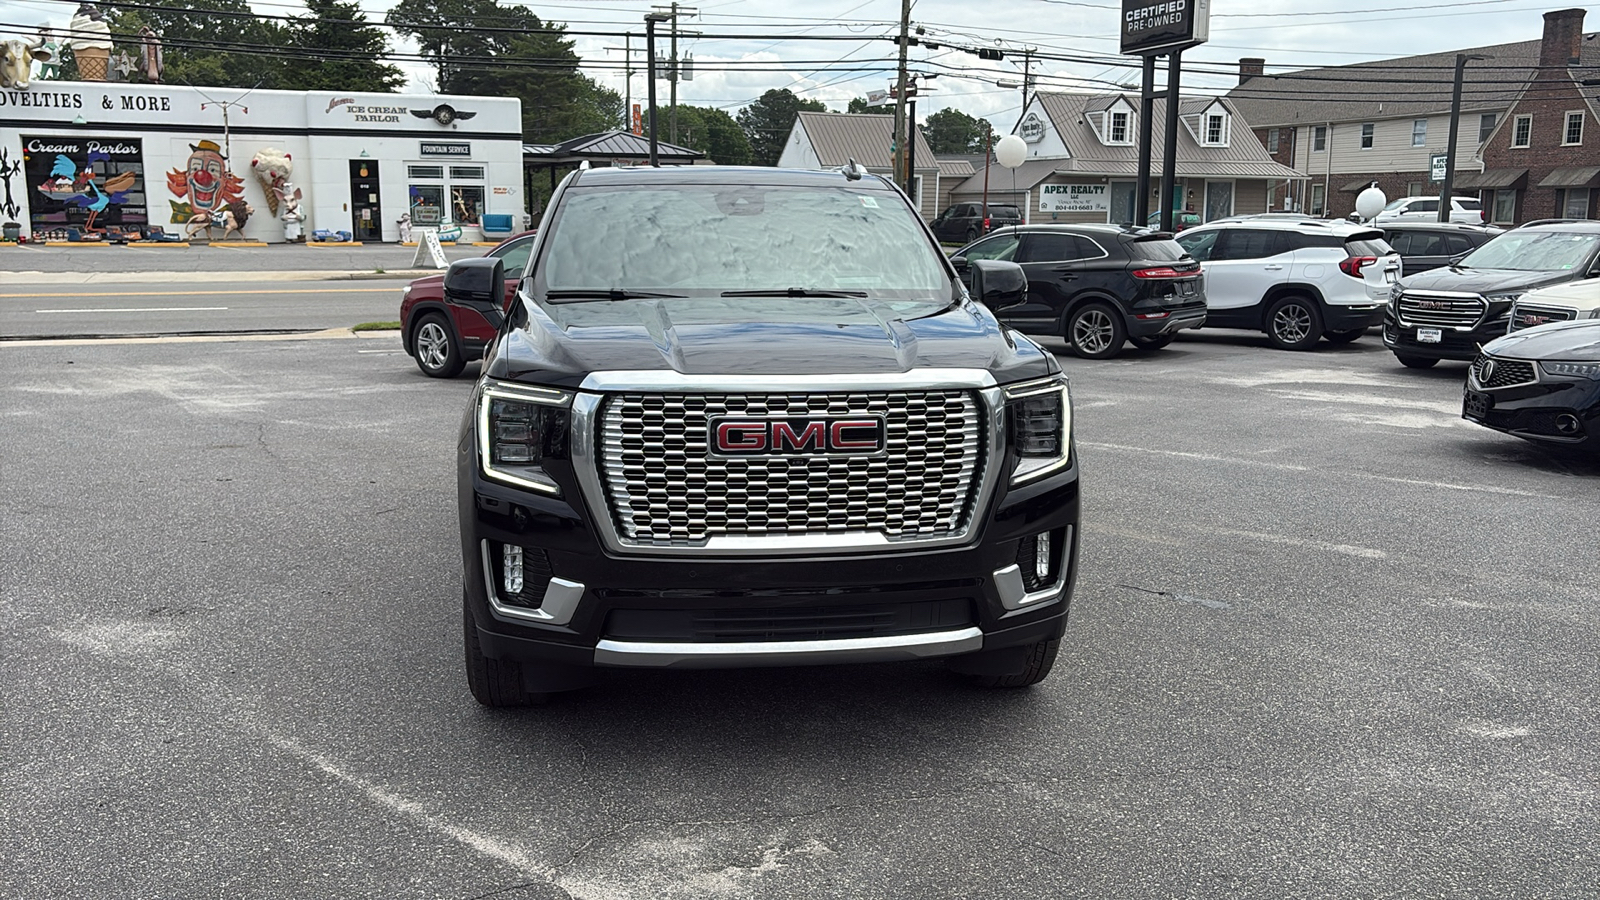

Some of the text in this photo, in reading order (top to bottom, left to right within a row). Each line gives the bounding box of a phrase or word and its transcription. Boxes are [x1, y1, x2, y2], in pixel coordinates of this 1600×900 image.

[1125, 0, 1186, 21] CERTIFIED
[1128, 12, 1182, 32] PRE-OWNED
[102, 95, 114, 110] &
[121, 96, 171, 111] MORE
[347, 105, 407, 114] ICE CREAM
[355, 114, 400, 122] PARLOR
[27, 139, 140, 154] Cream Parlor
[422, 145, 469, 154] FOUNTAIN SERVICE
[1044, 185, 1105, 194] APEX REALTY
[1419, 300, 1452, 310] GMC
[716, 420, 878, 451] GMC
